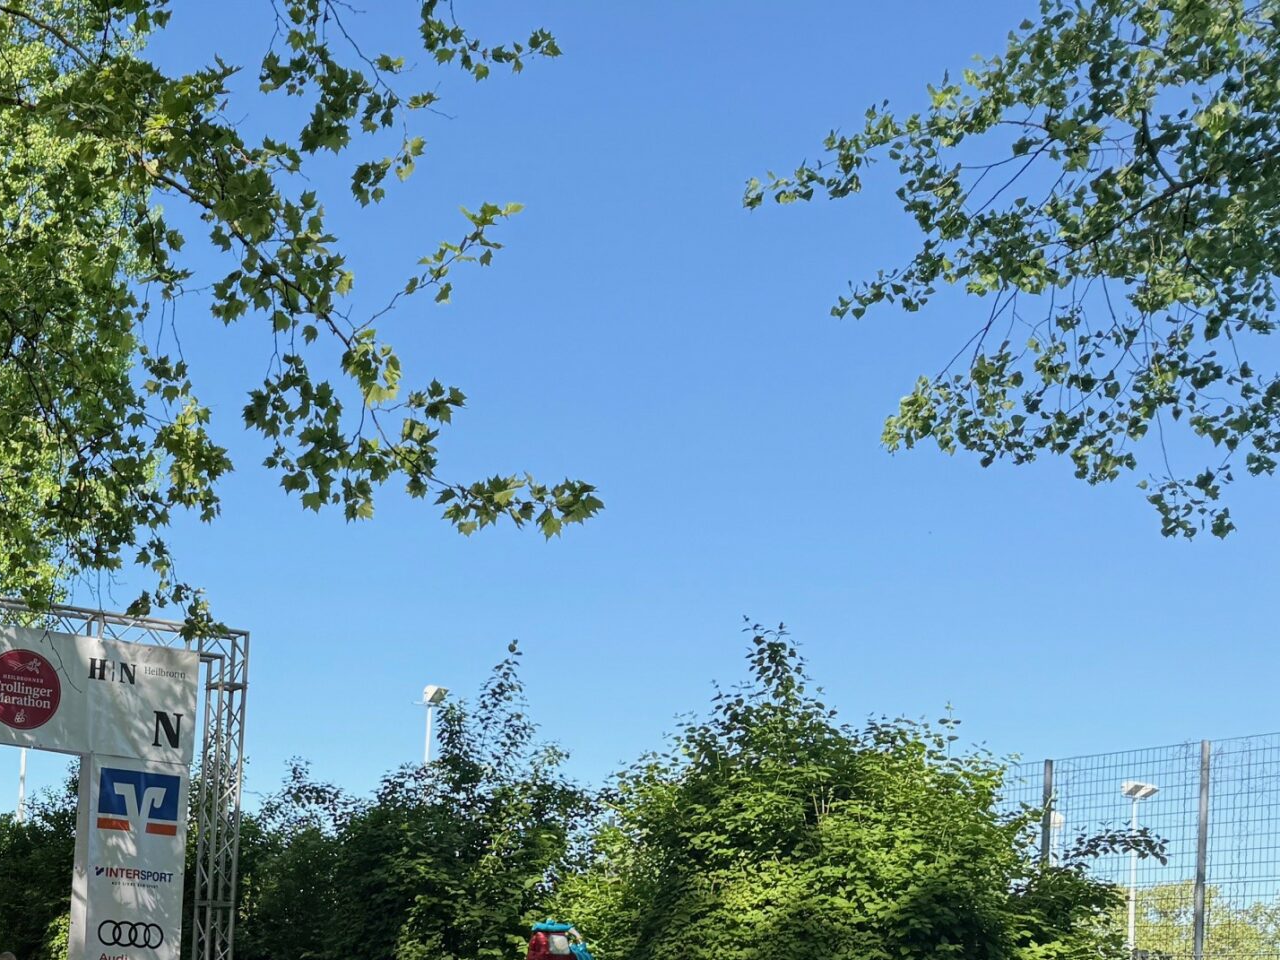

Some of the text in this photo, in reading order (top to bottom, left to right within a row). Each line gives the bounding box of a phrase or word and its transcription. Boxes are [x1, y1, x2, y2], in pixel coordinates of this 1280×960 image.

[144, 666, 187, 680] Heilbronn
[151, 710, 184, 749] N
[105, 867, 174, 883] INTERSPORT
